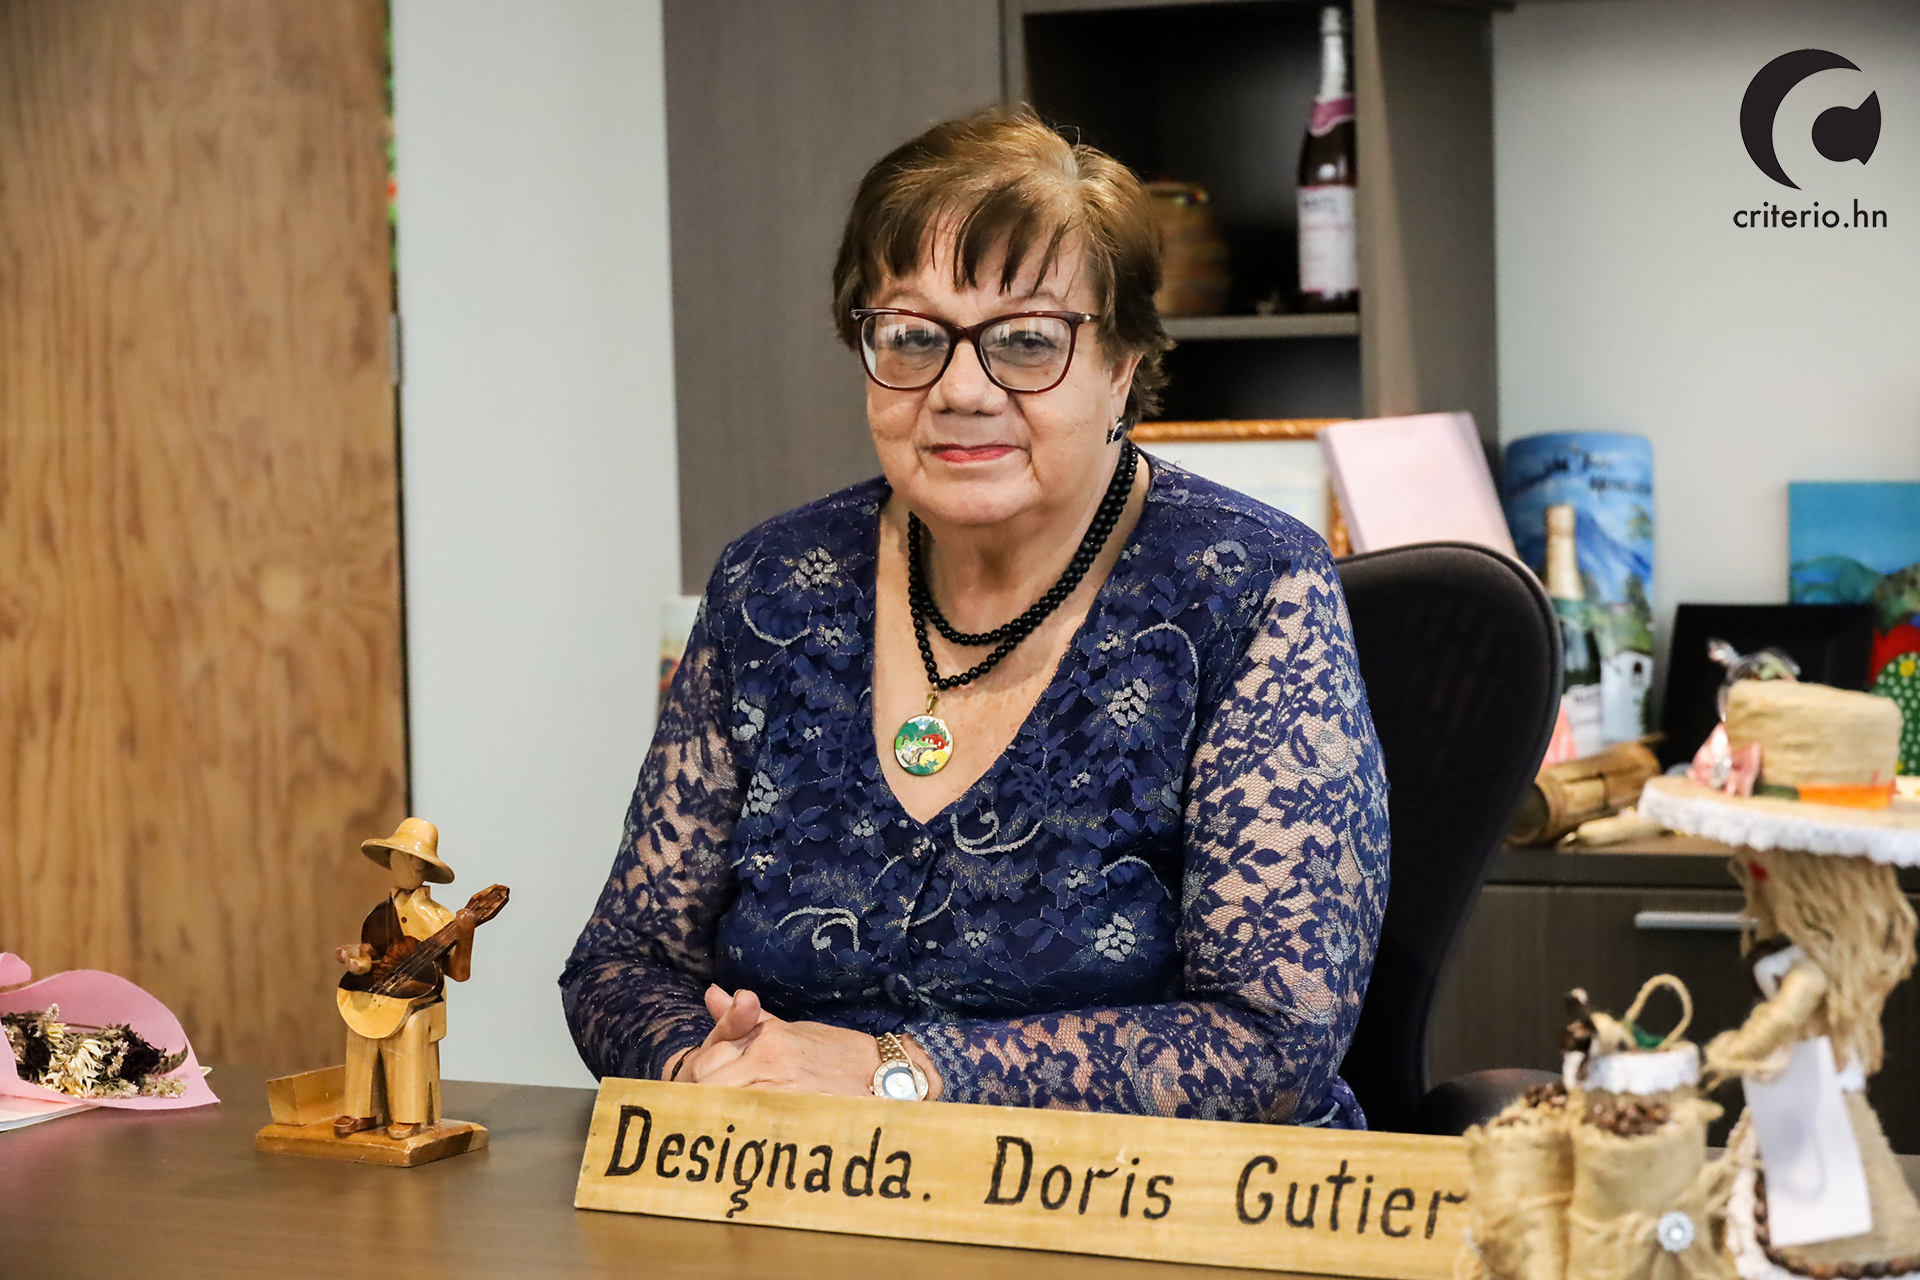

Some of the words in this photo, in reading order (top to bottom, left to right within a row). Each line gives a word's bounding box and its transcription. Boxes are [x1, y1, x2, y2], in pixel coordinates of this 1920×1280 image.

[604, 1105, 931, 1218] Designada.
[984, 1136, 1174, 1219] Doris
[1236, 1155, 1469, 1239] Gutier
